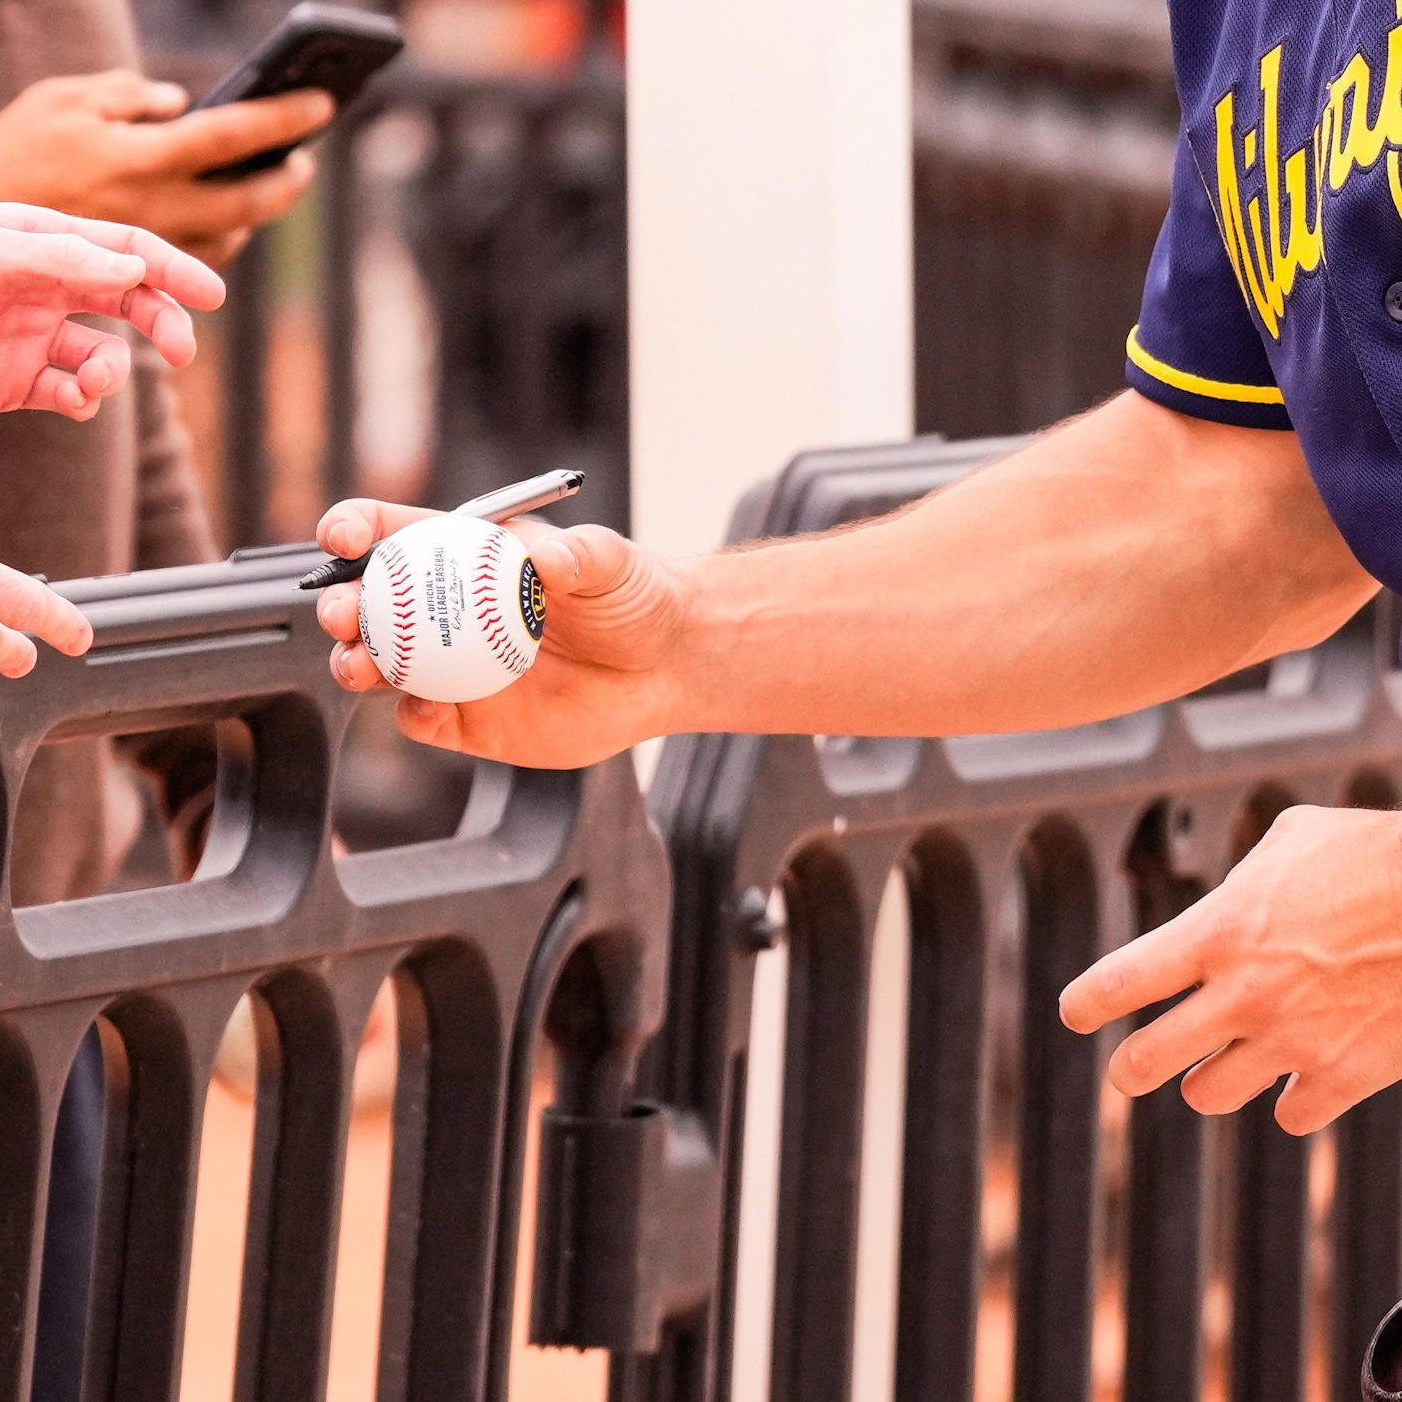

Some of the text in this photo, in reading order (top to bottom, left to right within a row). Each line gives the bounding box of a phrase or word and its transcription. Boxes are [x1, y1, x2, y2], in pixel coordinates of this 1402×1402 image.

[426, 580, 436, 612] OFFICIAL
[434, 547, 452, 647] MAJOR LEAGUE BASEBALL
